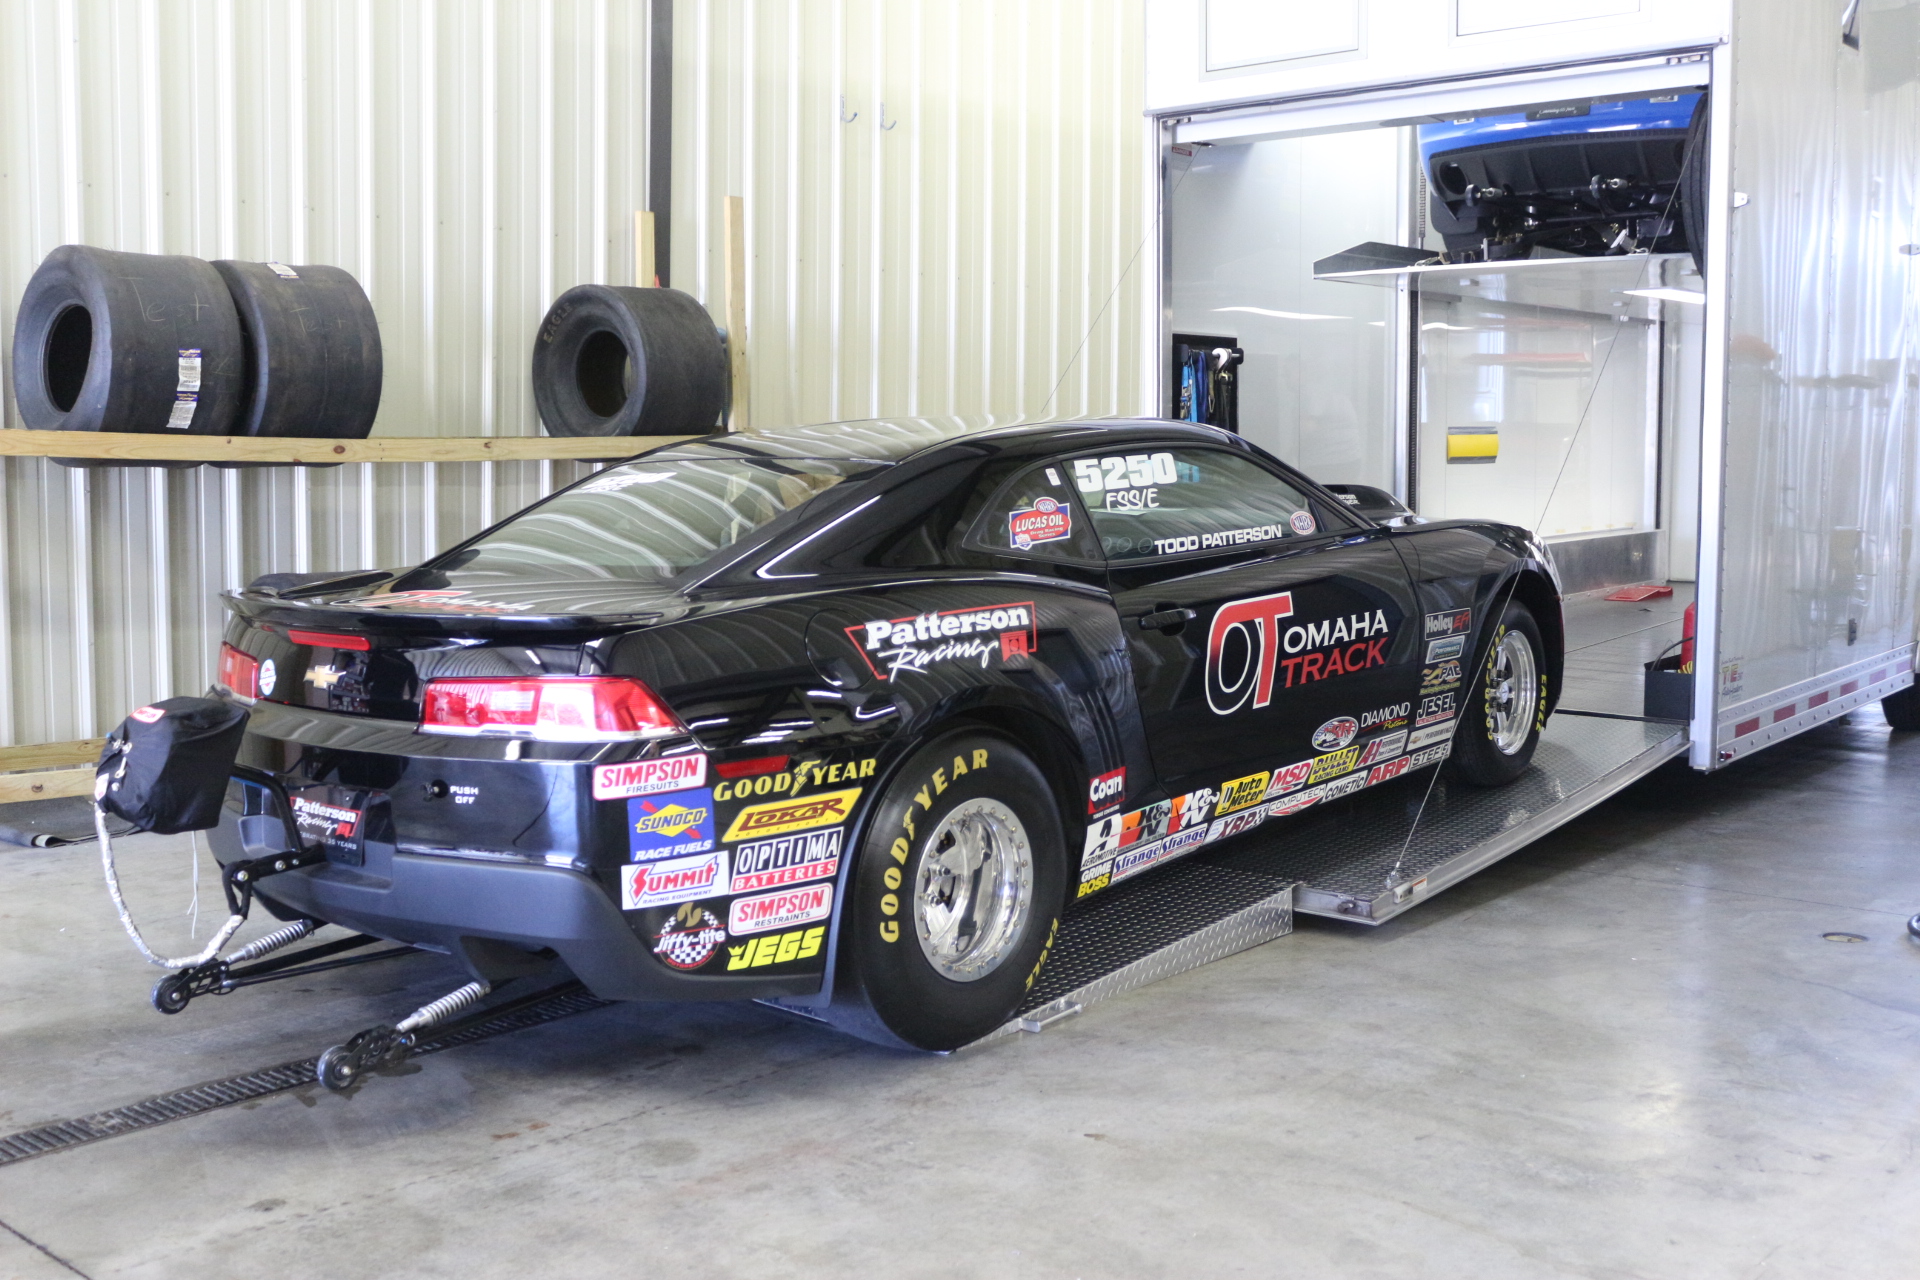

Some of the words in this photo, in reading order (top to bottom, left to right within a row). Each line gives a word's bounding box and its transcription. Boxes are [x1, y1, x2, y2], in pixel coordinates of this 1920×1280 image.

[1074, 453, 1178, 492] 5250
[1106, 488, 1160, 512] FSS/E
[1016, 516, 1048, 532] LUCAS
[1049, 514, 1064, 526] OIL
[1154, 538, 1199, 555] TODD
[1202, 524, 1282, 548] PATTERSON
[865, 607, 1029, 650] Patterson
[1284, 609, 1389, 654] OMAHA
[1426, 615, 1454, 634] Holley
[877, 638, 999, 683] Racing
[1281, 637, 1388, 688] TRACK
[1361, 702, 1410, 728] DIAMOND
[1417, 692, 1456, 719] JESEL
[1383, 719, 1409, 730] Pistons
[601, 757, 699, 788] SIMPSON
[1270, 762, 1311, 790] MSD
[1365, 756, 1410, 786] ARP
[450, 785, 479, 796] PUSH
[455, 795, 475, 804] OFF
[626, 780, 680, 795] FIRESUITS
[1090, 775, 1122, 802] Coan
[1230, 789, 1263, 808] Meter
[1235, 778, 1262, 795] Auto
[1269, 787, 1325, 811] COMPUTECH
[1325, 776, 1365, 798] COMETIC
[294, 797, 356, 823] Patterson
[638, 807, 706, 834] SUNOCO
[738, 798, 847, 832] LOKAR
[296, 812, 338, 835] Racing
[634, 847, 672, 861] RACE
[674, 840, 712, 857] FUELS
[738, 832, 839, 874] OPTIMA
[1162, 829, 1205, 855] Strange
[1081, 847, 1118, 868] AEROMOTIVE
[1114, 846, 1159, 874] Strange
[735, 861, 836, 890] BATTERIES
[1081, 860, 1113, 883] GRIME
[643, 896, 670, 905] RACING
[671, 889, 712, 901] EQUIPMENT
[1077, 873, 1110, 898] BOSS
[737, 890, 824, 922] SIMPSON
[754, 911, 811, 928] RESTRAINTS
[727, 926, 825, 970] JEGS
